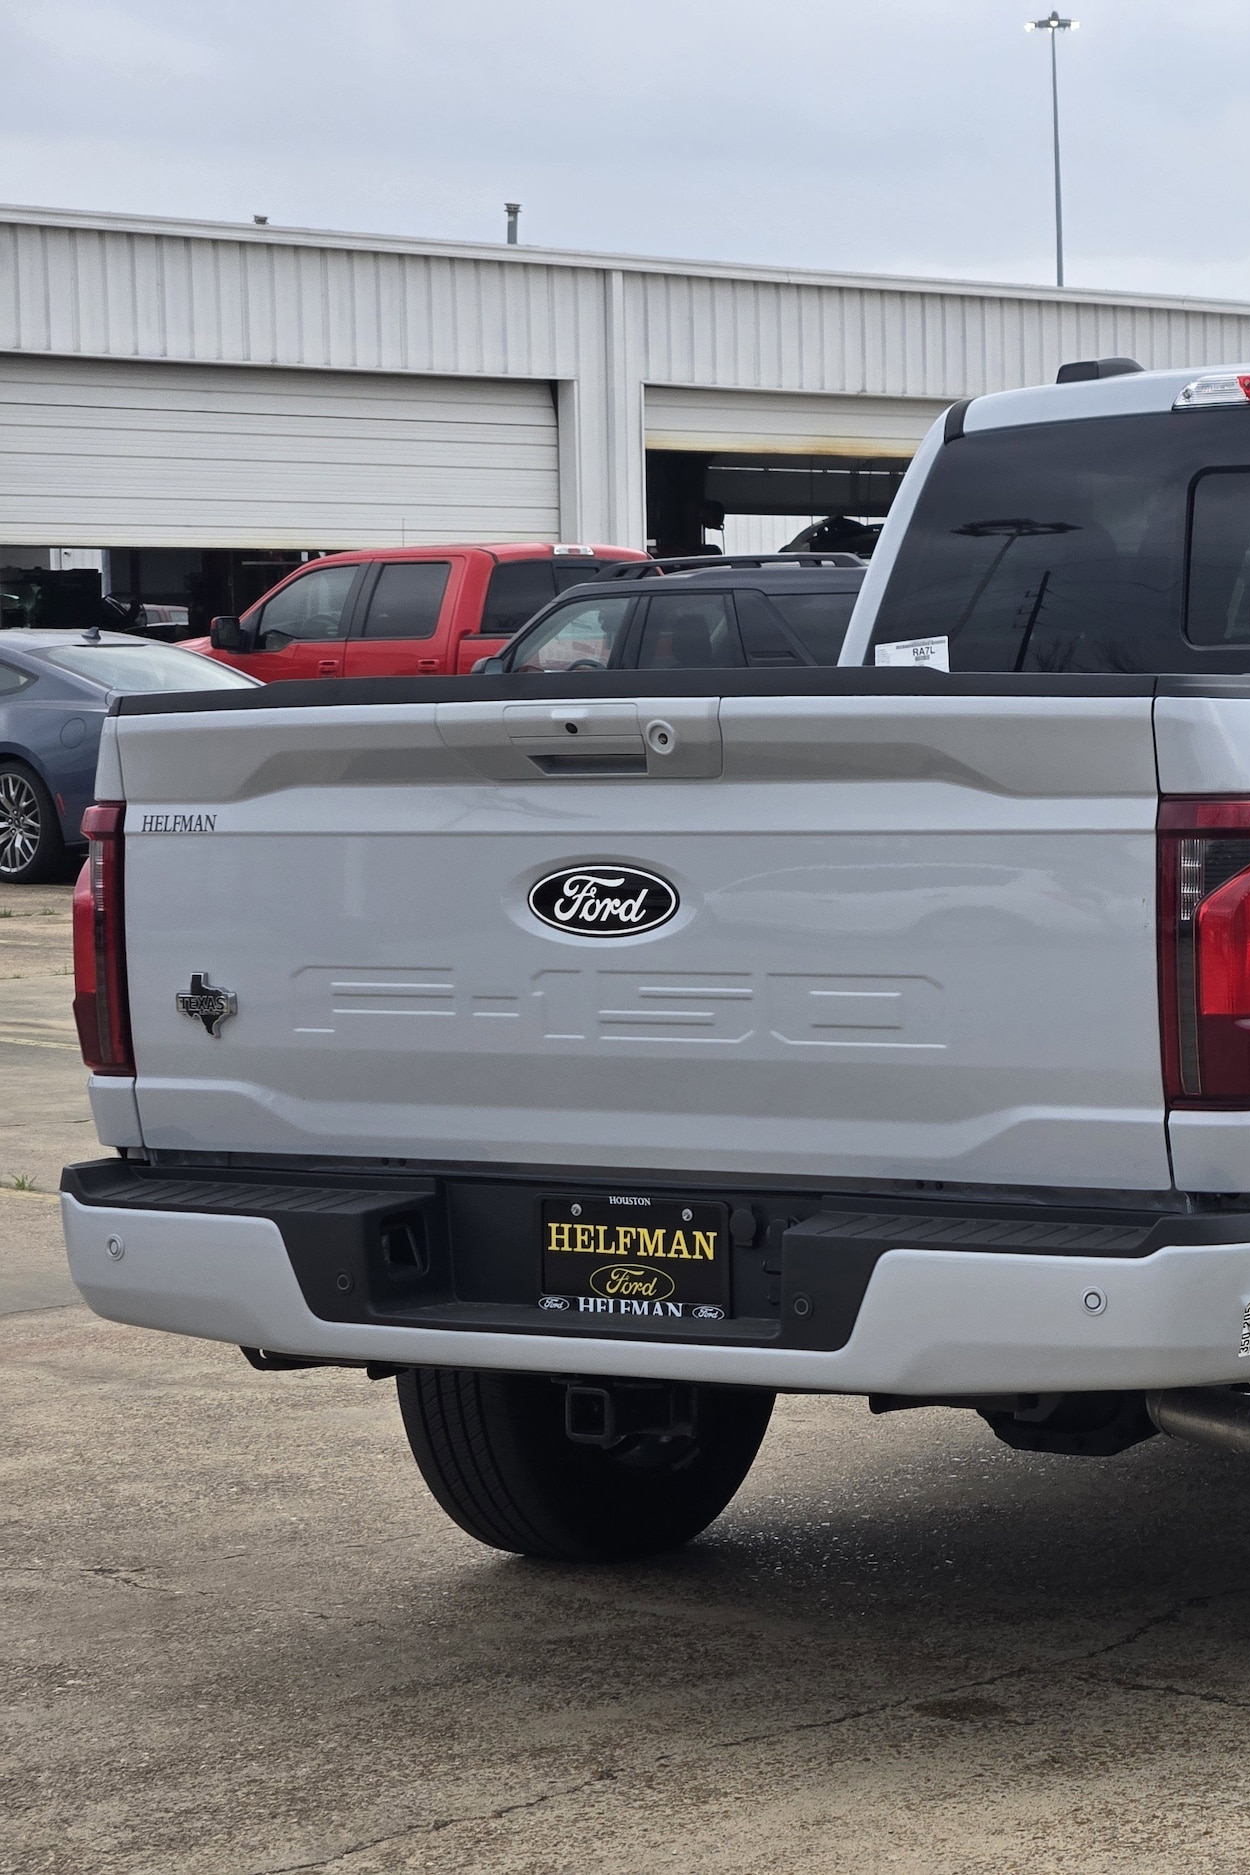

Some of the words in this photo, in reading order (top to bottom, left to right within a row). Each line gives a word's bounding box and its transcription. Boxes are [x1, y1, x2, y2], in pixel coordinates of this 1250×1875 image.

[912, 645, 936, 657] RA7L
[141, 814, 218, 832] HELFMAN
[554, 875, 649, 923] Ford
[179, 995, 226, 1011] TEXAS
[290, 964, 948, 1049] F-150
[608, 1196, 651, 1206] HOUSTON
[547, 1222, 718, 1261] HELFMAN
[605, 1267, 657, 1297] Ford
[543, 1297, 564, 1309] Ford
[578, 1296, 683, 1318] HELFMAN
[697, 1307, 719, 1319] Ford
[1238, 1332, 1250, 1354] 350
